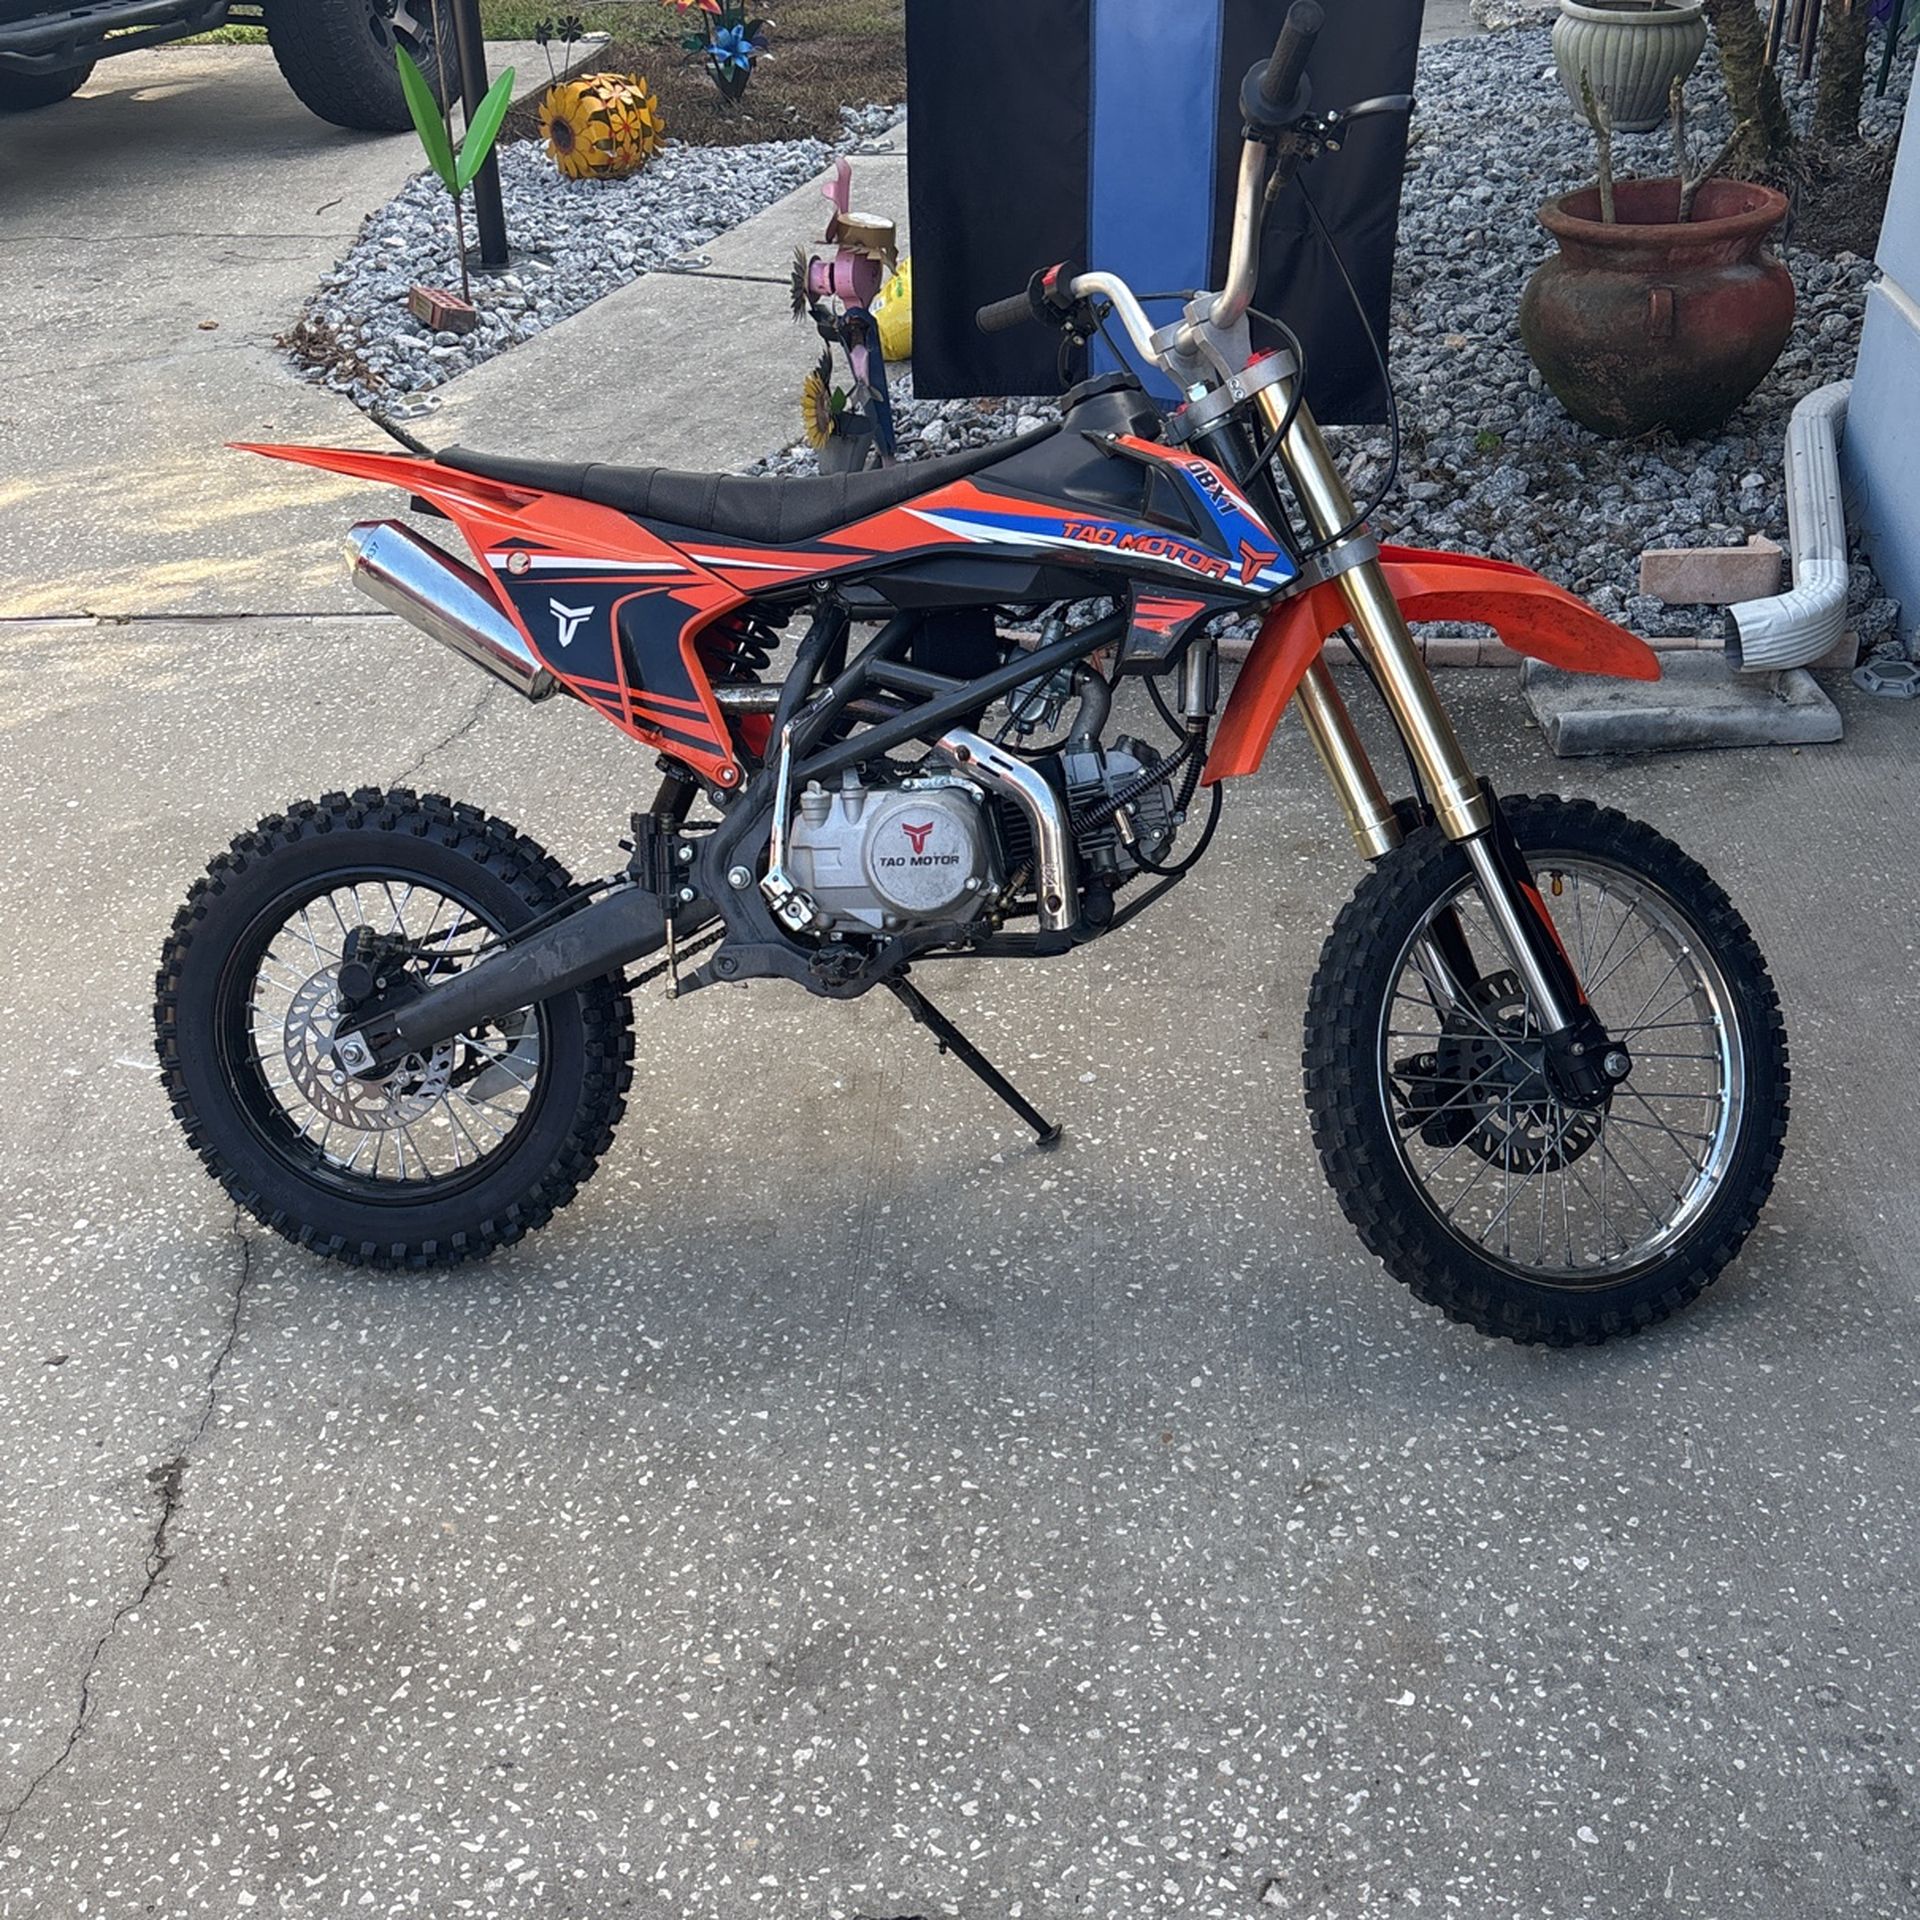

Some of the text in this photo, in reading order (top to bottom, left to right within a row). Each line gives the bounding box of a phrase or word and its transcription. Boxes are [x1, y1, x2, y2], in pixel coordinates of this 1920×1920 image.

[1063, 522, 1231, 581] TAO MOTOR
[880, 856, 960, 867] TAO MOTOR
